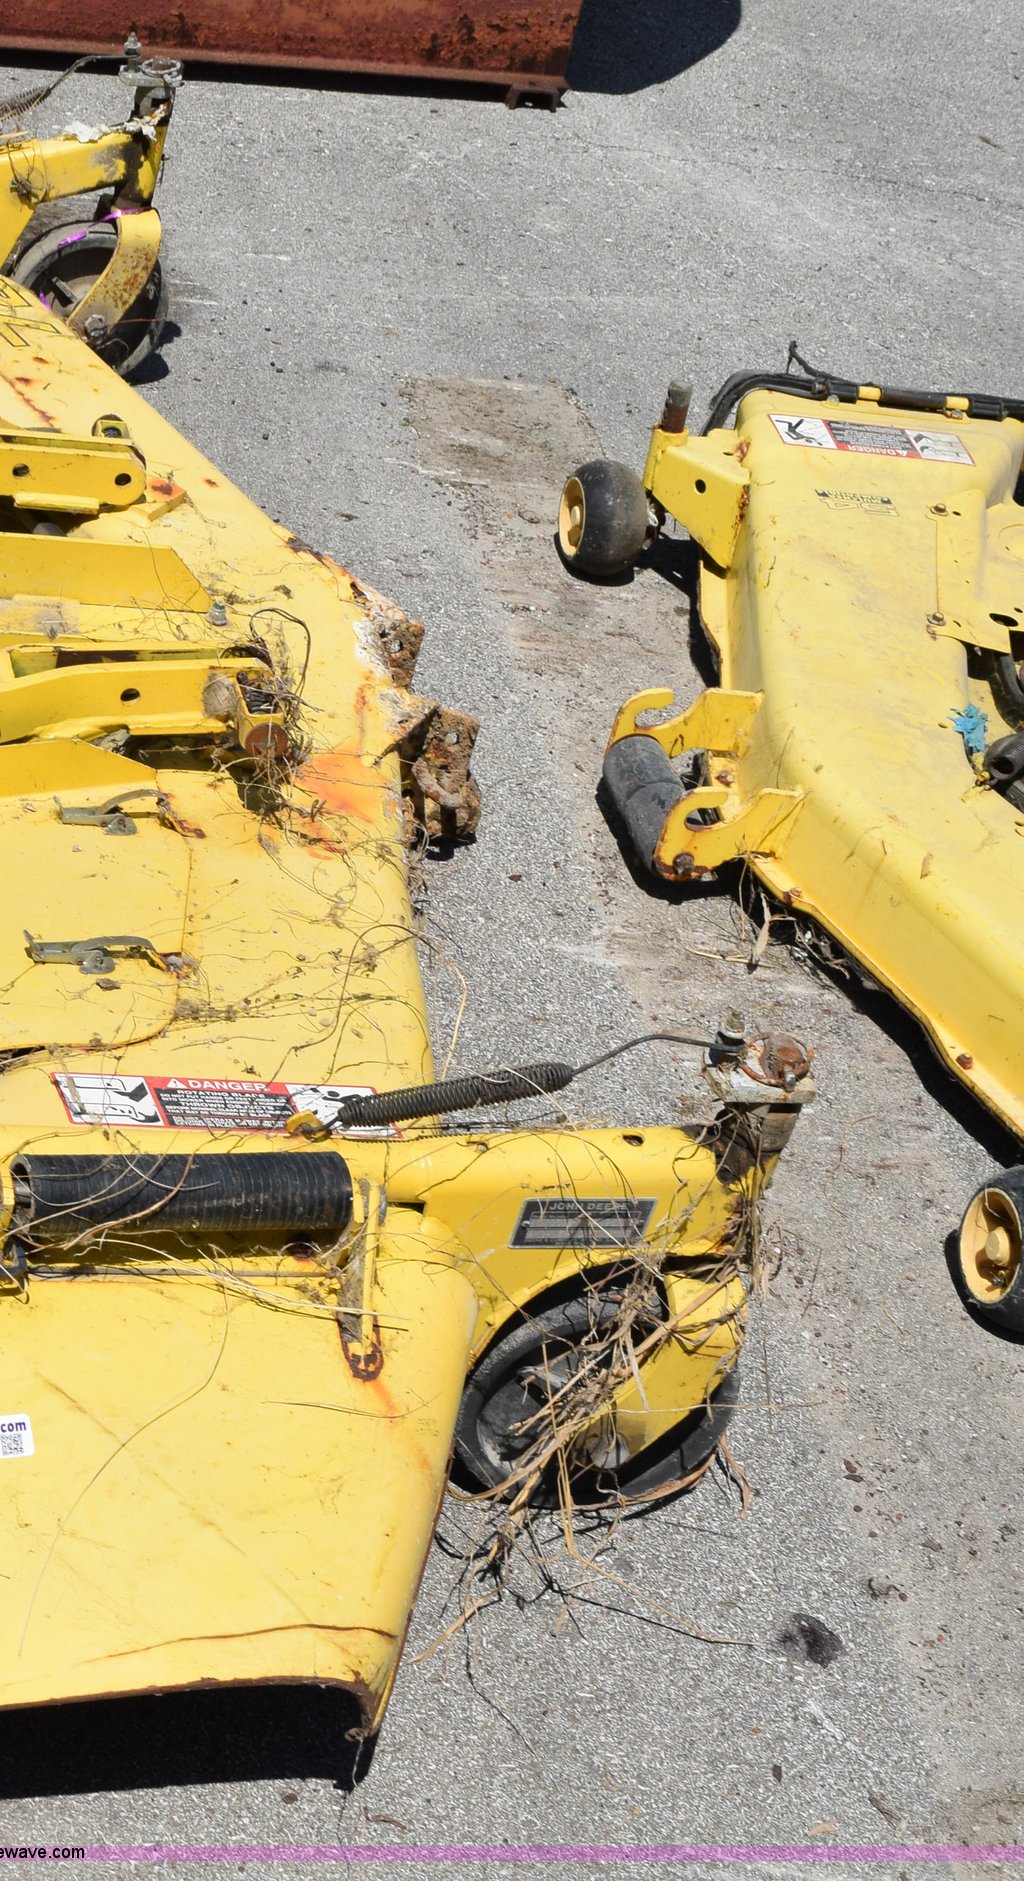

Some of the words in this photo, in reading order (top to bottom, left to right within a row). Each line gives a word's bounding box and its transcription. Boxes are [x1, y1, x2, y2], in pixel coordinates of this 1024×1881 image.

[847, 444, 897, 457] DANGER
[187, 1080, 270, 1092] DANGER
[549, 1202, 586, 1211] JOHN
